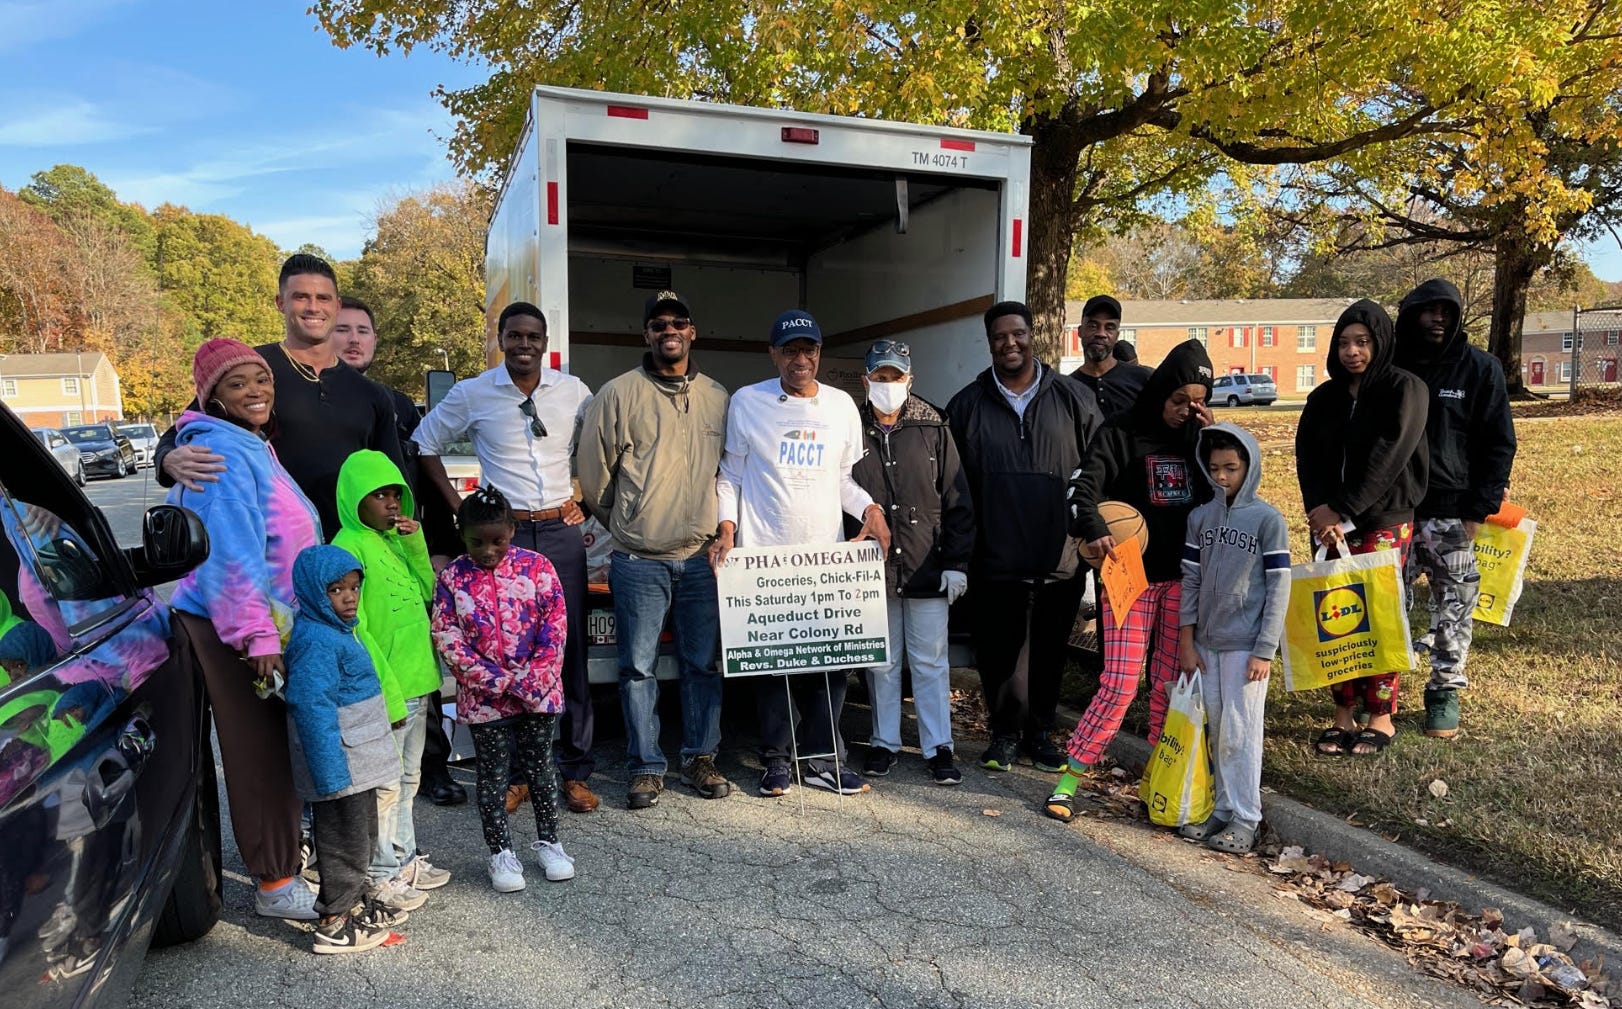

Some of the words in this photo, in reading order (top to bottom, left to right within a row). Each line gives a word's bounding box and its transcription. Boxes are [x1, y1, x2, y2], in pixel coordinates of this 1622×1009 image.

[912, 152, 929, 165] TM
[932, 154, 958, 168] 4074
[961, 156, 968, 169] T
[782, 318, 813, 330] PACCT
[779, 441, 824, 466] PACCT
[791, 551, 854, 567] OMEGA
[857, 547, 883, 563] MIN.
[756, 574, 817, 589] Groceries,
[820, 570, 881, 584] Chick-Fil-A
[726, 596, 752, 608] This
[755, 592, 807, 607] Saturday
[810, 591, 835, 604] 1pm
[838, 589, 852, 601] To
[855, 588, 879, 601] 2pm
[747, 609, 819, 626] Aqueduct
[824, 606, 862, 619] Drive
[748, 630, 784, 642] Near
[789, 625, 839, 640] Colony
[844, 624, 863, 636] Rd
[728, 649, 752, 662] Alpha
[755, 649, 762, 658] &
[763, 647, 794, 659] Omega
[795, 644, 832, 655] Network
[833, 643, 842, 652] of
[844, 640, 885, 651] Ministries
[1316, 638, 1378, 658] suspiciously
[740, 660, 773, 671] Revs.
[777, 658, 807, 668] Duke
[811, 656, 820, 665] &
[824, 653, 875, 664] Duchess
[1321, 650, 1375, 668] low-priced
[1327, 661, 1373, 681] groceries
